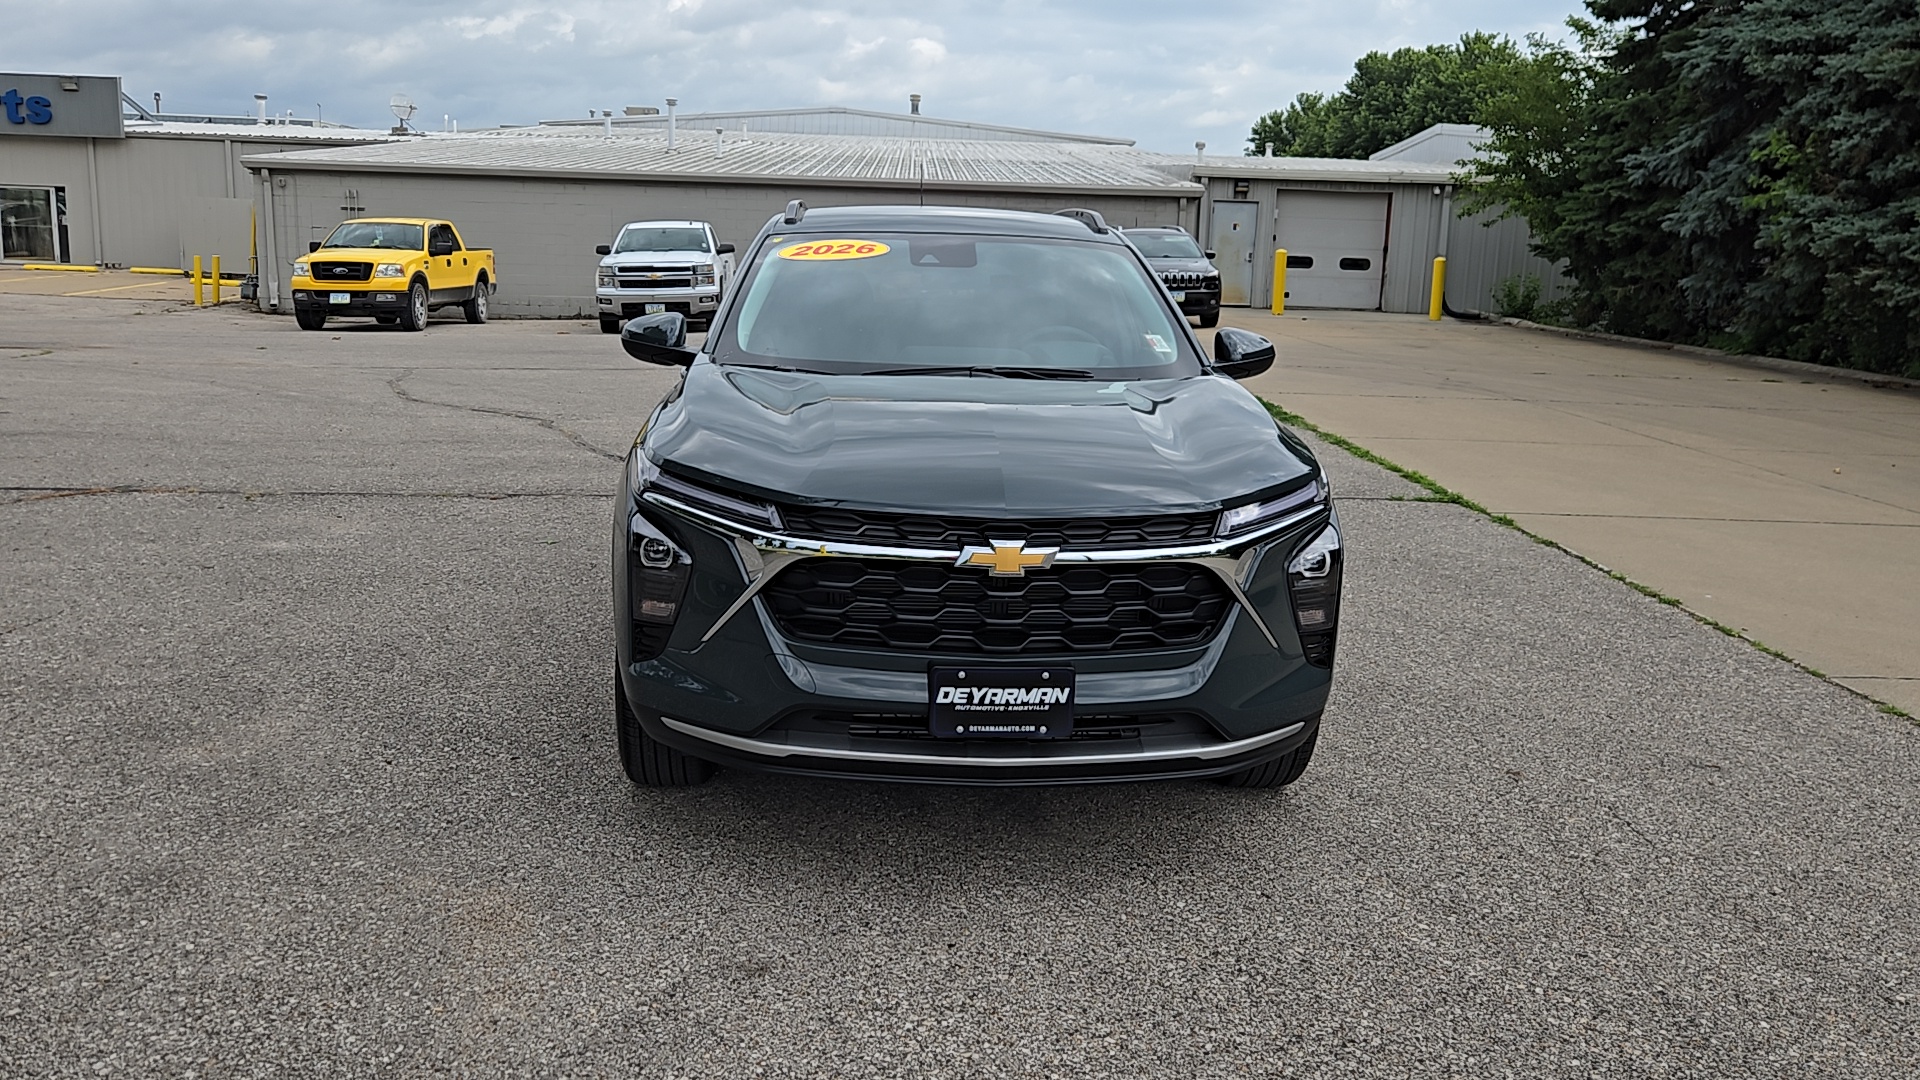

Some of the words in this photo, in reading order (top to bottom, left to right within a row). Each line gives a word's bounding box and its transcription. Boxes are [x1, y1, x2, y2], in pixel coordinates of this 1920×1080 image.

[0, 88, 53, 125] ts
[789, 244, 877, 257] 2026
[935, 686, 1070, 704] DEYARMAN
[969, 724, 1036, 733] DEYARMANAUTO.COM
